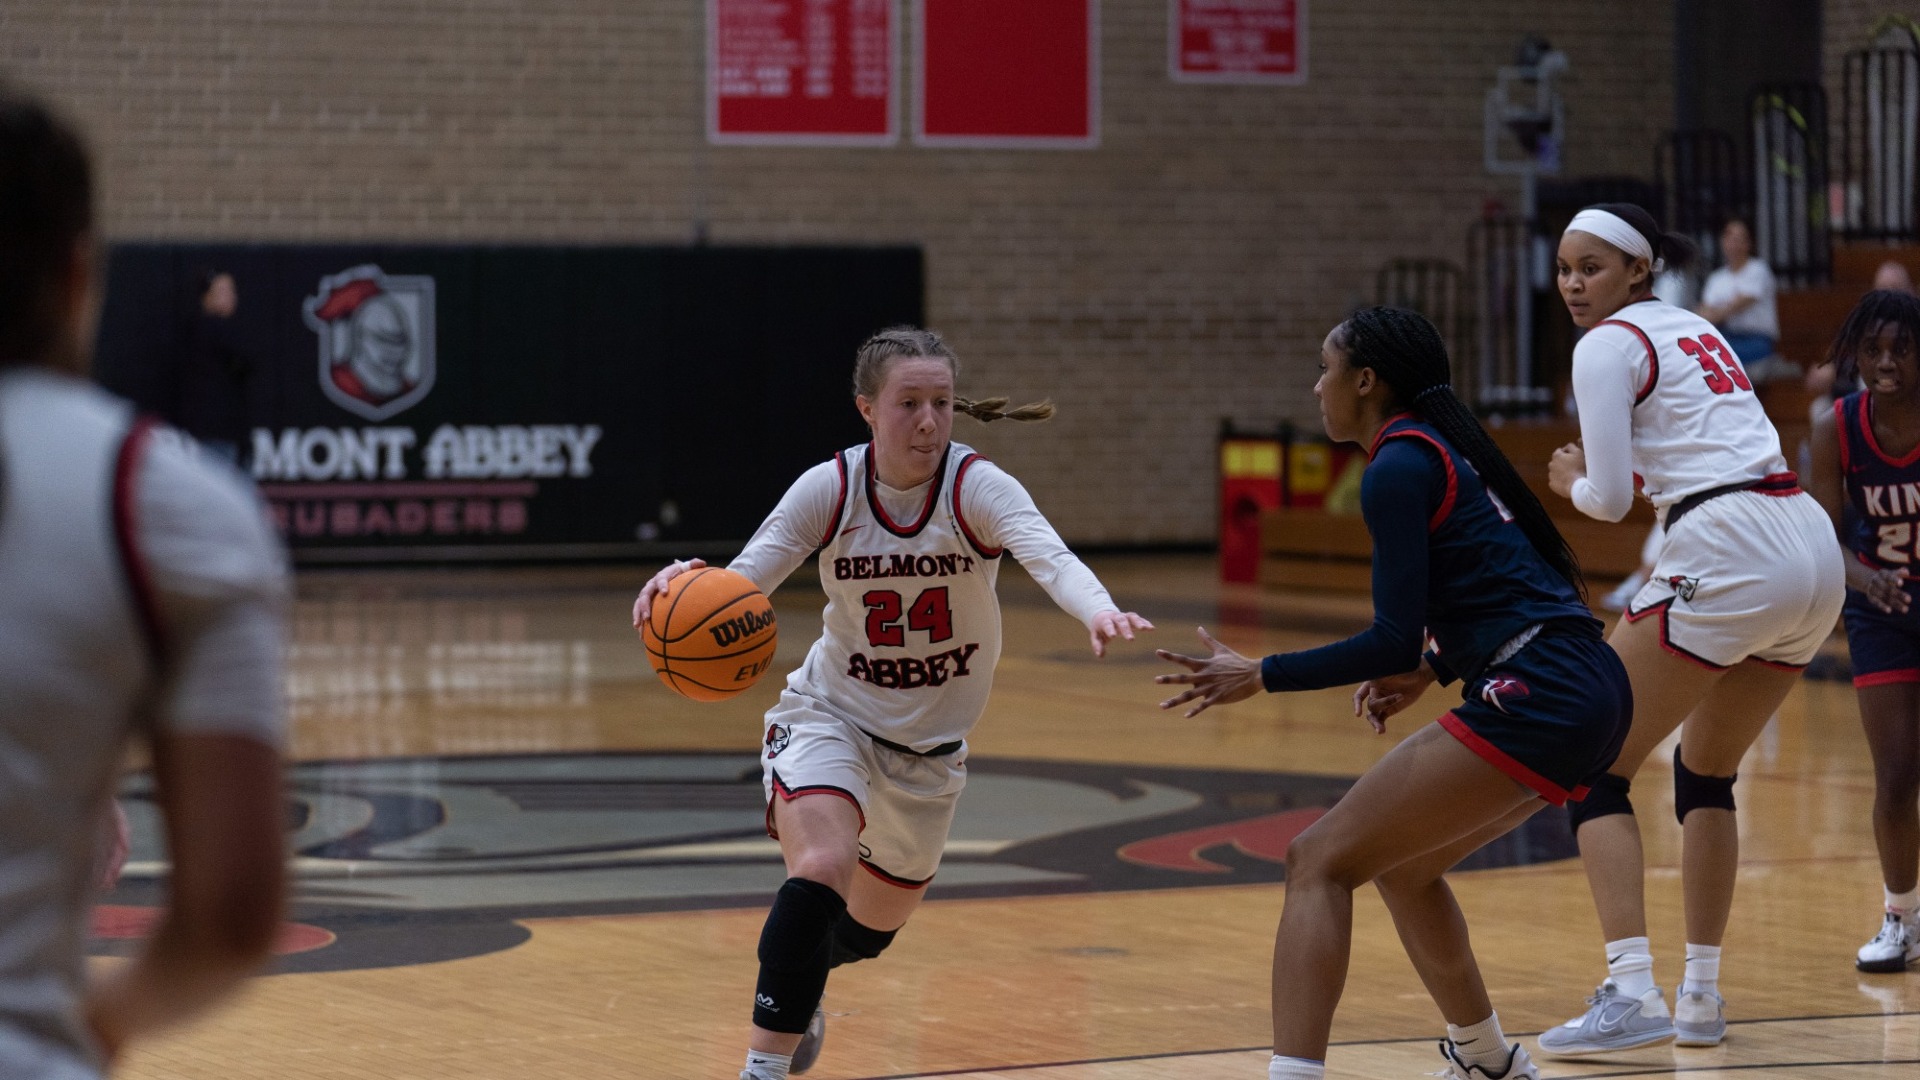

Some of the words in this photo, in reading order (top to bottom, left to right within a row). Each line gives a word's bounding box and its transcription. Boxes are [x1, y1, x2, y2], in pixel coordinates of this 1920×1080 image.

[1677, 333, 1752, 394] 33
[252, 426, 416, 480] MONT
[424, 424, 602, 478] ABBEY
[1876, 521, 1920, 564] 2
[833, 553, 975, 580] BELMONT
[709, 610, 776, 647] Wilson
[862, 586, 953, 647] 24
[847, 643, 979, 689] ABBEY
